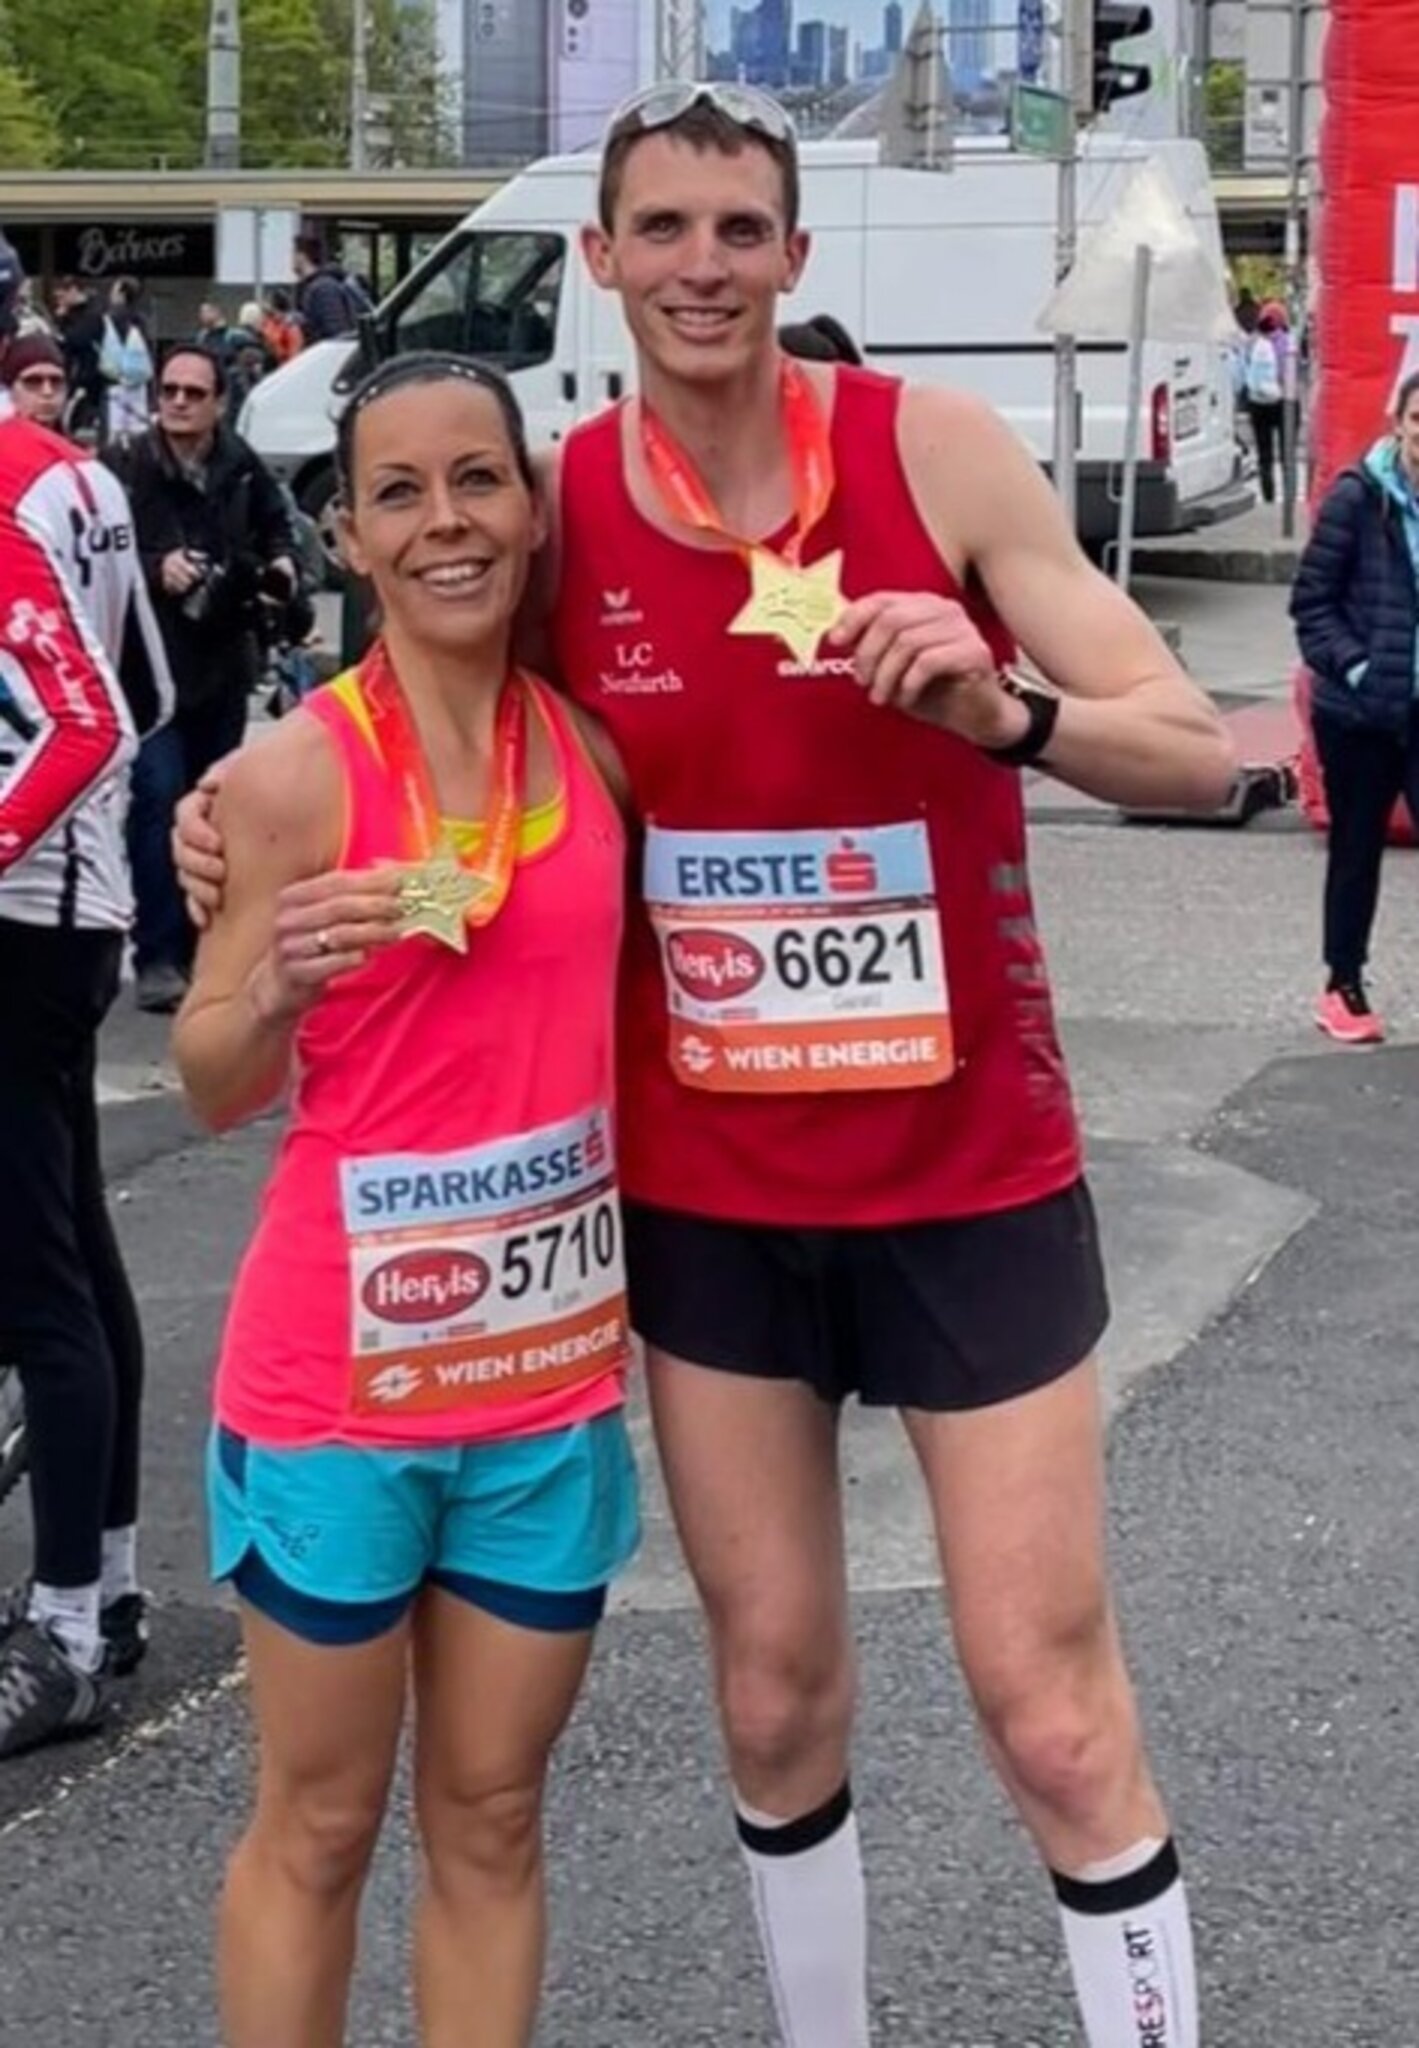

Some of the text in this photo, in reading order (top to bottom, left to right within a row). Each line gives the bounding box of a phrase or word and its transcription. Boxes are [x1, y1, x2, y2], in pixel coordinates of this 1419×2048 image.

[615, 642, 654, 669] LC
[676, 854, 820, 897] ERSTE
[773, 920, 924, 990] 6621
[723, 1036, 938, 1071] WIEN ENERGIE
[357, 1143, 582, 1216] SPARKASSE
[501, 1203, 615, 1300] 5710
[375, 1265, 481, 1306] Hervis
[433, 1357, 517, 1387] WIEN
[522, 1317, 622, 1372] ENERGIE
